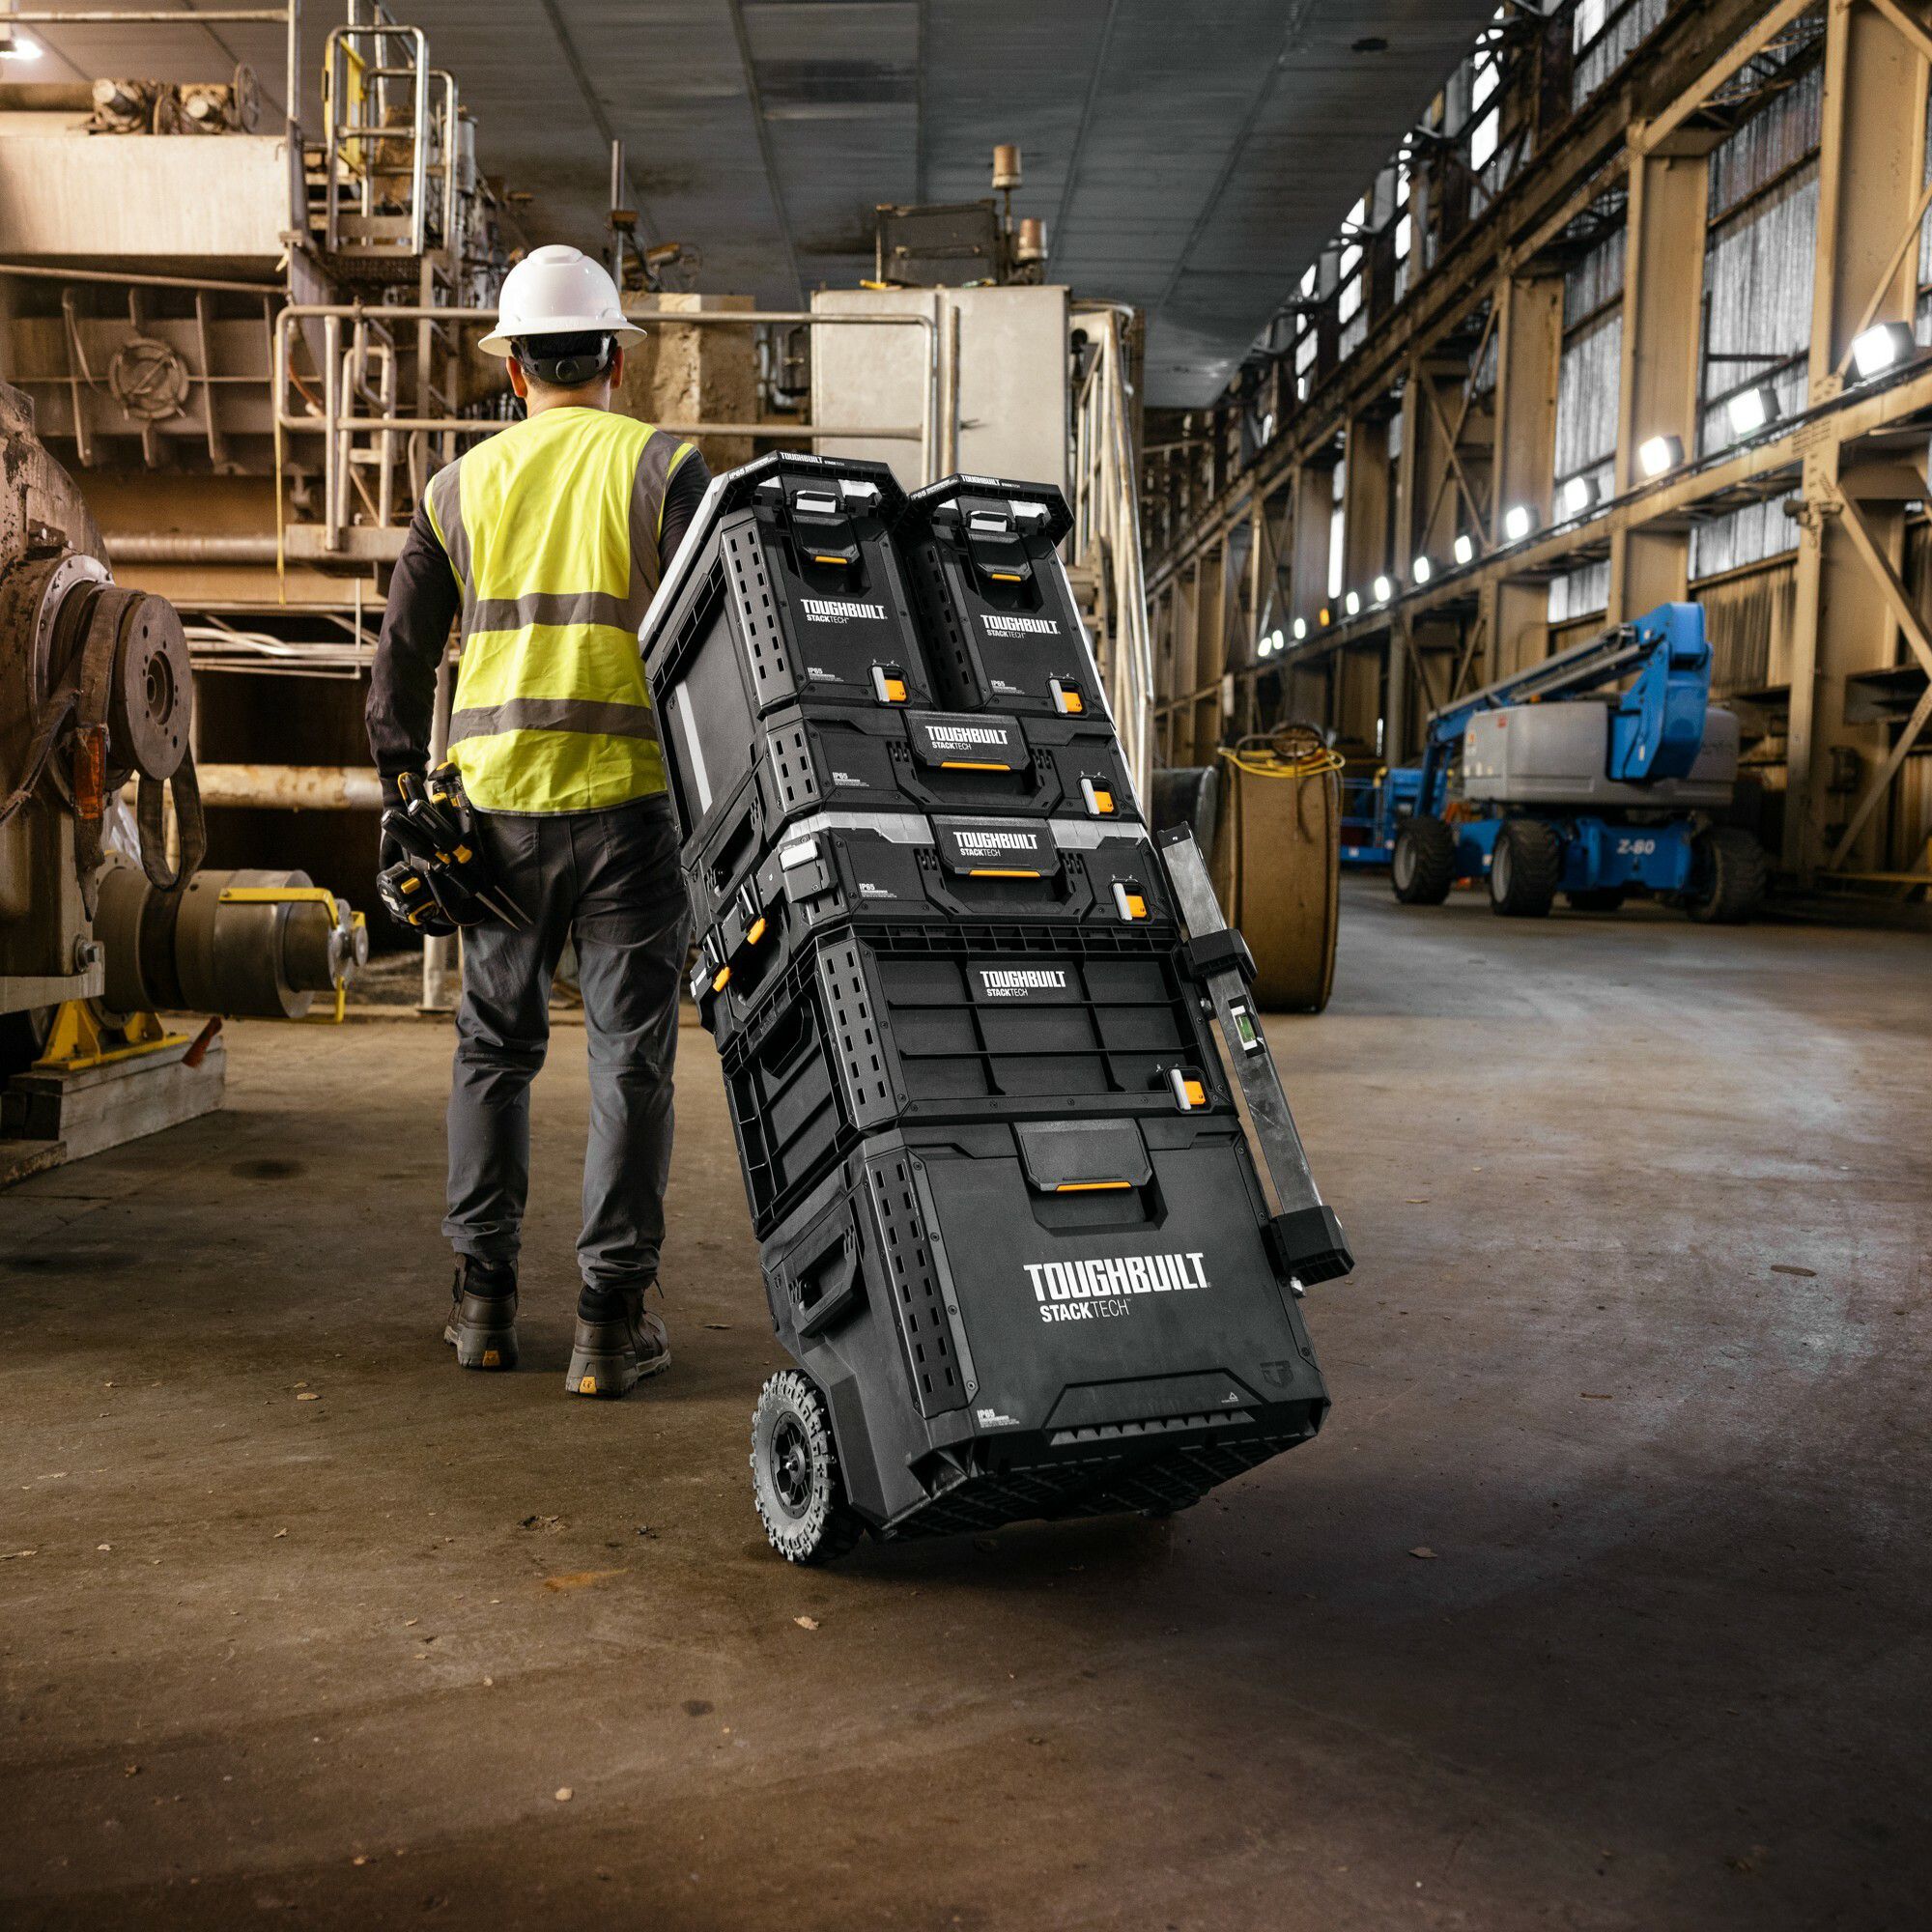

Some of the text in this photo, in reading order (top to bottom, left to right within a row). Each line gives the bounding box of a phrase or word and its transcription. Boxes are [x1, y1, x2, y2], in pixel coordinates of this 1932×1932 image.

[780, 451, 823, 464] TOUGHBUILT
[960, 474, 1000, 486] TOUGHBUILT
[800, 599, 886, 619] TOUGHBUILT
[807, 613, 848, 624] STACKTECH
[980, 614, 1059, 635] TOUGHBUILT
[986, 629, 1025, 639] STACKTECH
[924, 725, 1009, 745] TOUGHBUILT
[932, 741, 972, 751] STACKTECH
[952, 832, 1038, 849] TOUGHBUILT
[960, 848, 1001, 857] STACKTECH
[980, 971, 1066, 987] TOUGHBUILT
[986, 988, 1029, 997] STACKTECH
[1023, 1252, 1208, 1301] TOUGHBUILT
